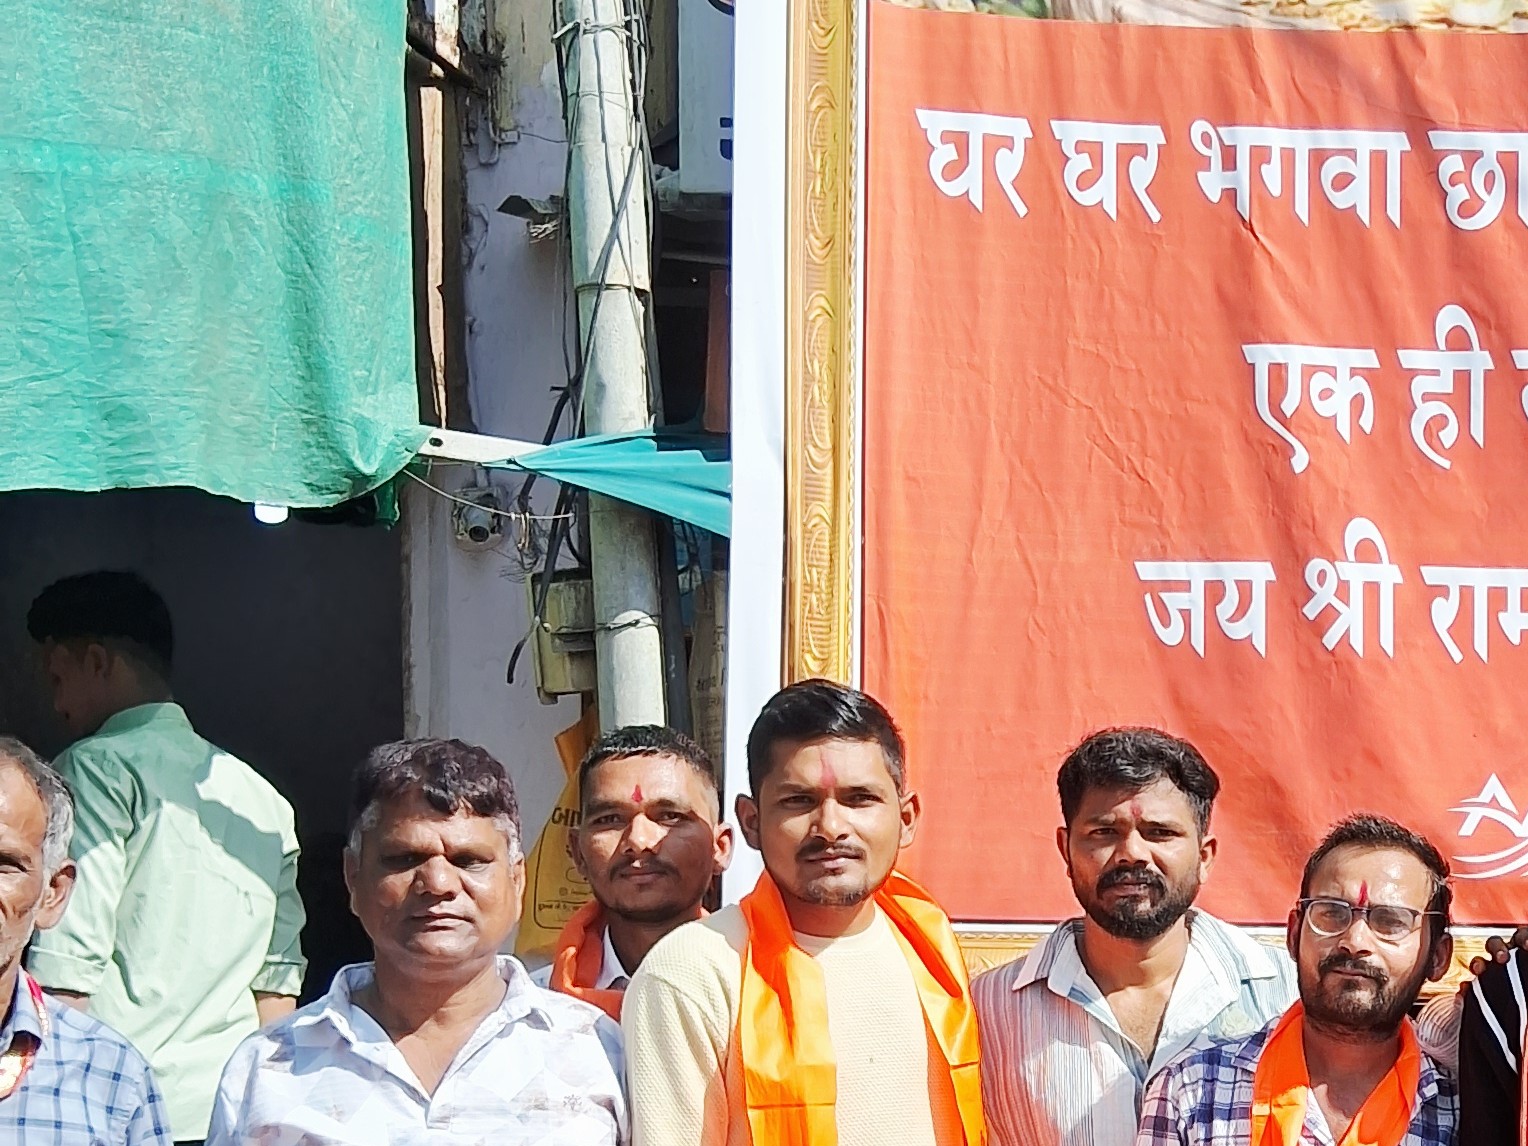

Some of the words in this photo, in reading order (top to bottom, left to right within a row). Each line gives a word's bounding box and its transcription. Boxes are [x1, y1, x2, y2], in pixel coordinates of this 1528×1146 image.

[915, 108, 1033, 218] घर
[1050, 120, 1166, 222] घर
[1191, 120, 1411, 228] भगवा
[1242, 344, 1380, 474] एक
[1397, 305, 1495, 469] ही
[1134, 561, 1276, 658] जय
[1303, 517, 1403, 658] श्री
